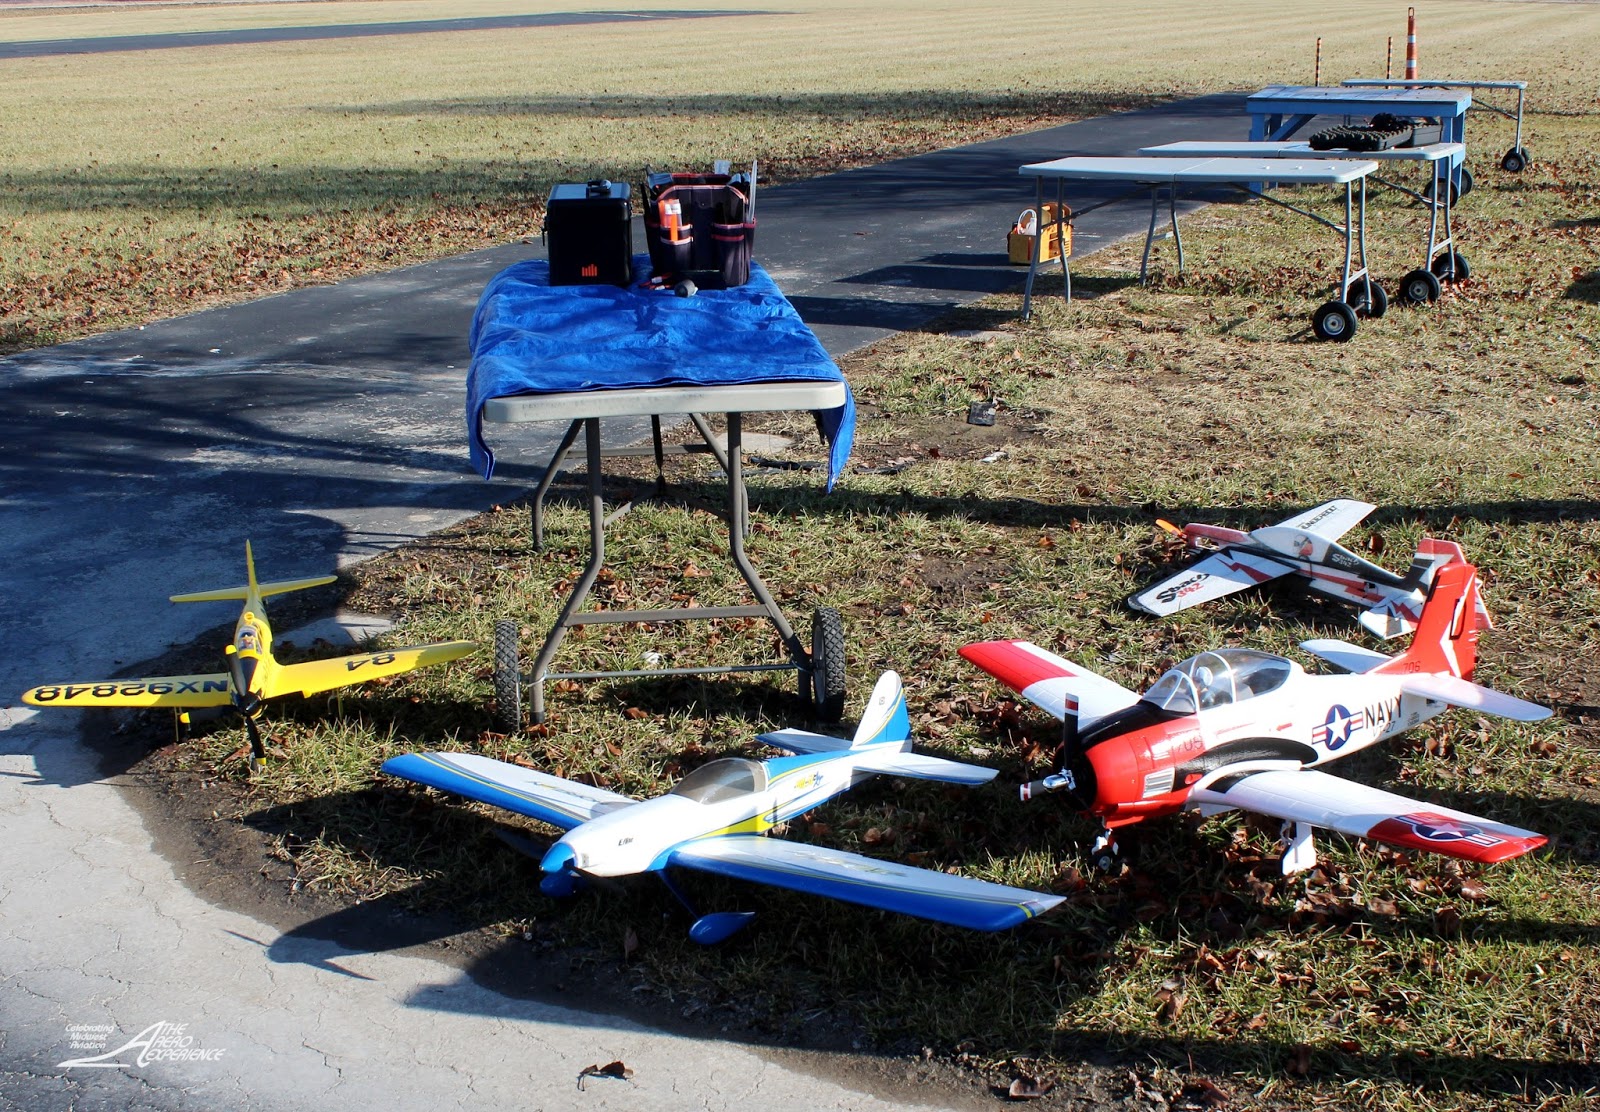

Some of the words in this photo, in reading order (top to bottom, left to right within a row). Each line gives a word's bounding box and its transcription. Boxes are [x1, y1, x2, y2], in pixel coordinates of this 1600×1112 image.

[345, 653, 396, 672] 84
[1403, 661, 1421, 673] 706
[34, 680, 228, 702] NX92848
[1365, 694, 1402, 729] NAVY
